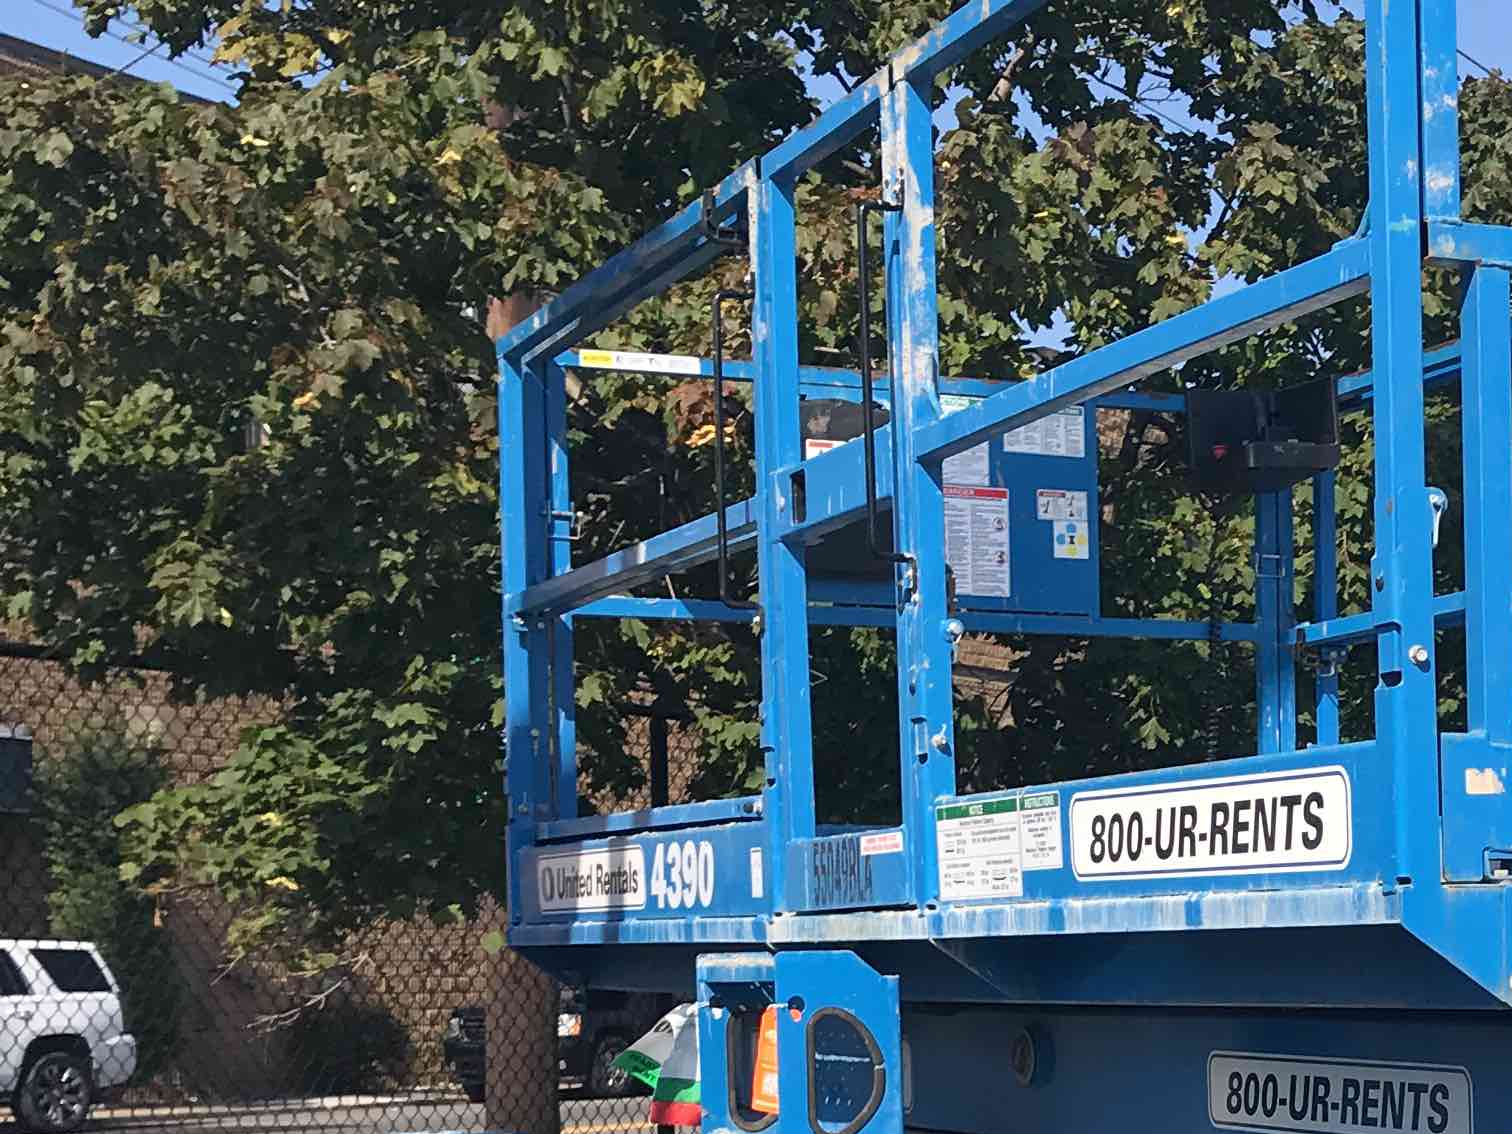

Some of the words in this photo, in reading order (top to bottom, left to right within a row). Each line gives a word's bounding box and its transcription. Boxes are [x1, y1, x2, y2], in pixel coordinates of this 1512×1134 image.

[1090, 791, 1325, 864] 800-UR-RENTS
[556, 867, 592, 899] United
[596, 860, 639, 898] Rentals
[650, 840, 715, 910] 4390
[1226, 1070, 1450, 1134] 800-UR-RENTS
